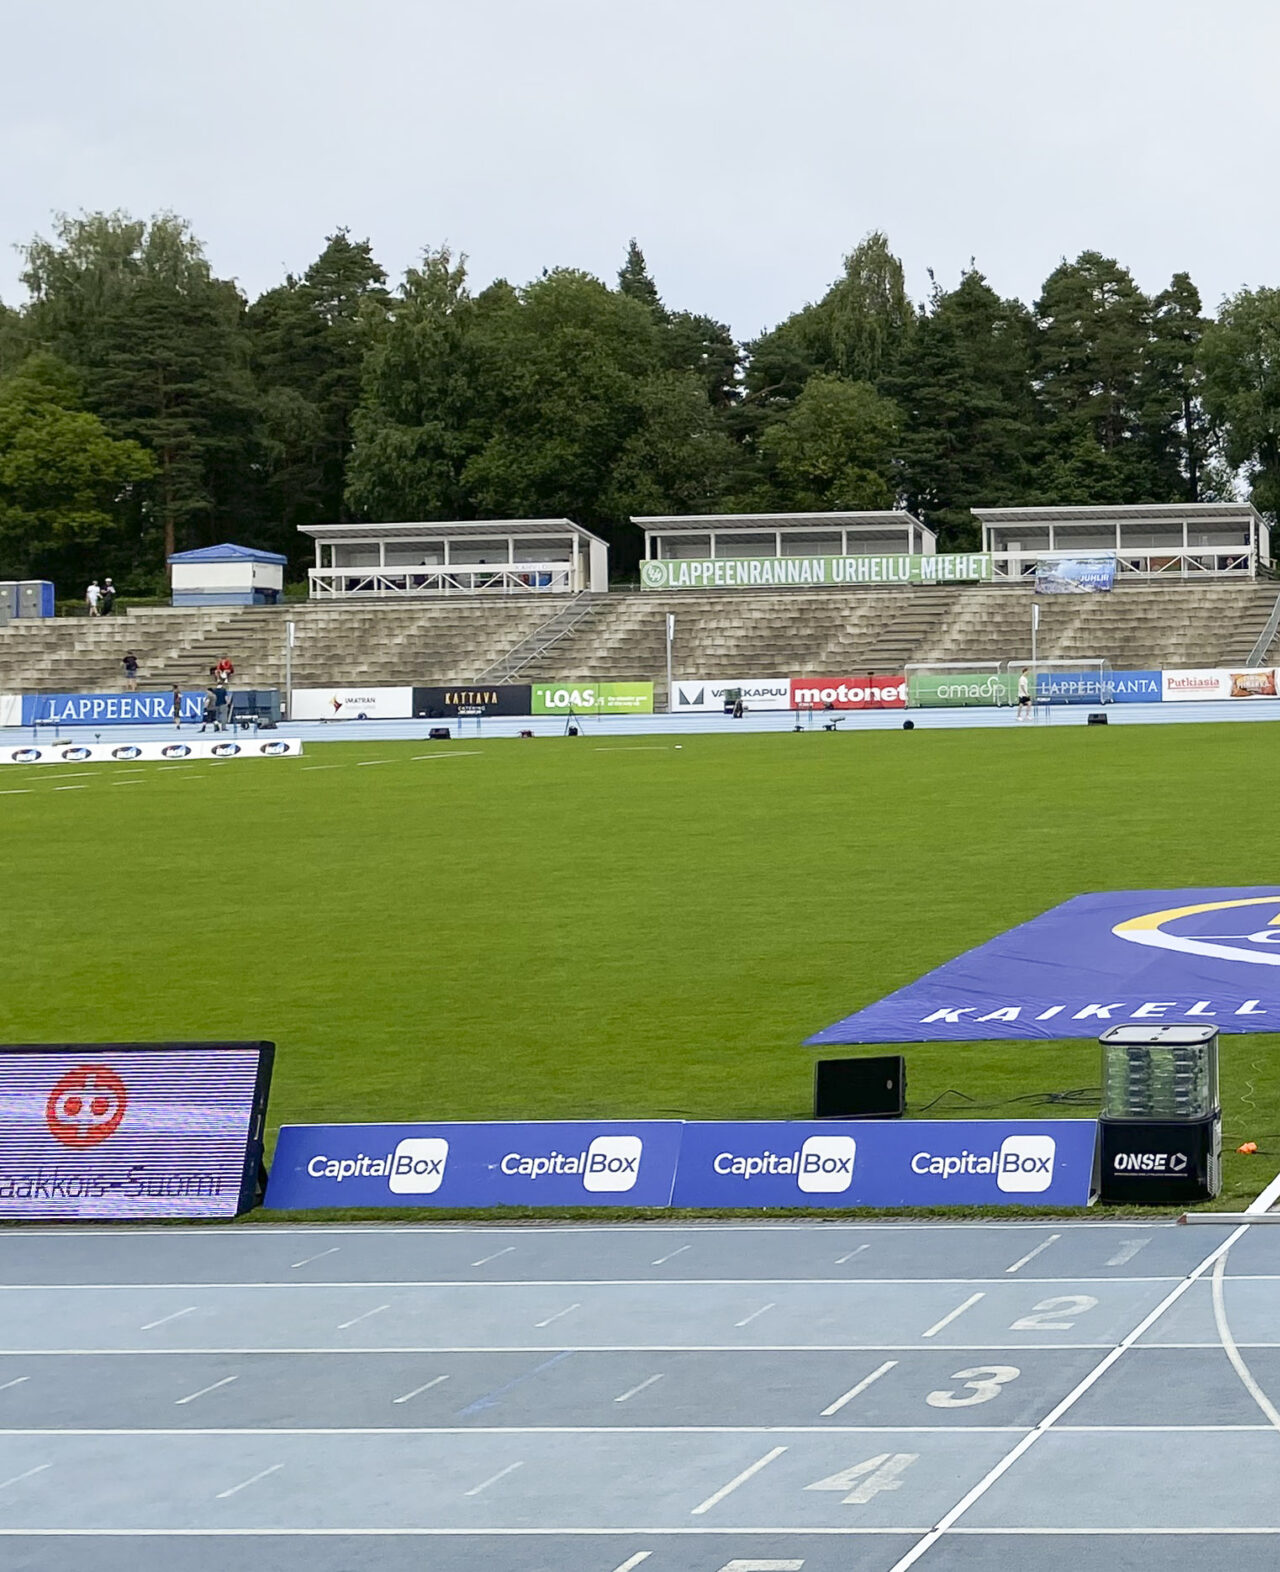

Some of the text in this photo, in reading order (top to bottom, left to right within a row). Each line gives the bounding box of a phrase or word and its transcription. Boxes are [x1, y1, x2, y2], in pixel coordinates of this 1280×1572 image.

[668, 559, 825, 586] LAPPEENRANNAN
[832, 555, 989, 582] URHEILU-MIEHET
[711, 688, 788, 698] VAKAPUU
[795, 683, 908, 703] motonet
[1042, 679, 1159, 696] LAPPEENRANTA
[1168, 677, 1220, 688] Putkiasia
[50, 695, 207, 720] LAPPEENRN
[445, 691, 498, 705] KATTAVA
[307, 1152, 444, 1182] CapitalBox
[500, 1151, 637, 1180] CapitalBox
[713, 1150, 852, 1180] CapitalBox
[911, 1150, 1052, 1180] CapitalBox
[1113, 1153, 1168, 1171] ONSE
[0, 1165, 223, 1198] aakkois-Suomi
[1009, 1295, 1099, 1331] 2
[925, 1365, 1021, 1408] 3
[803, 1453, 920, 1505] 4
